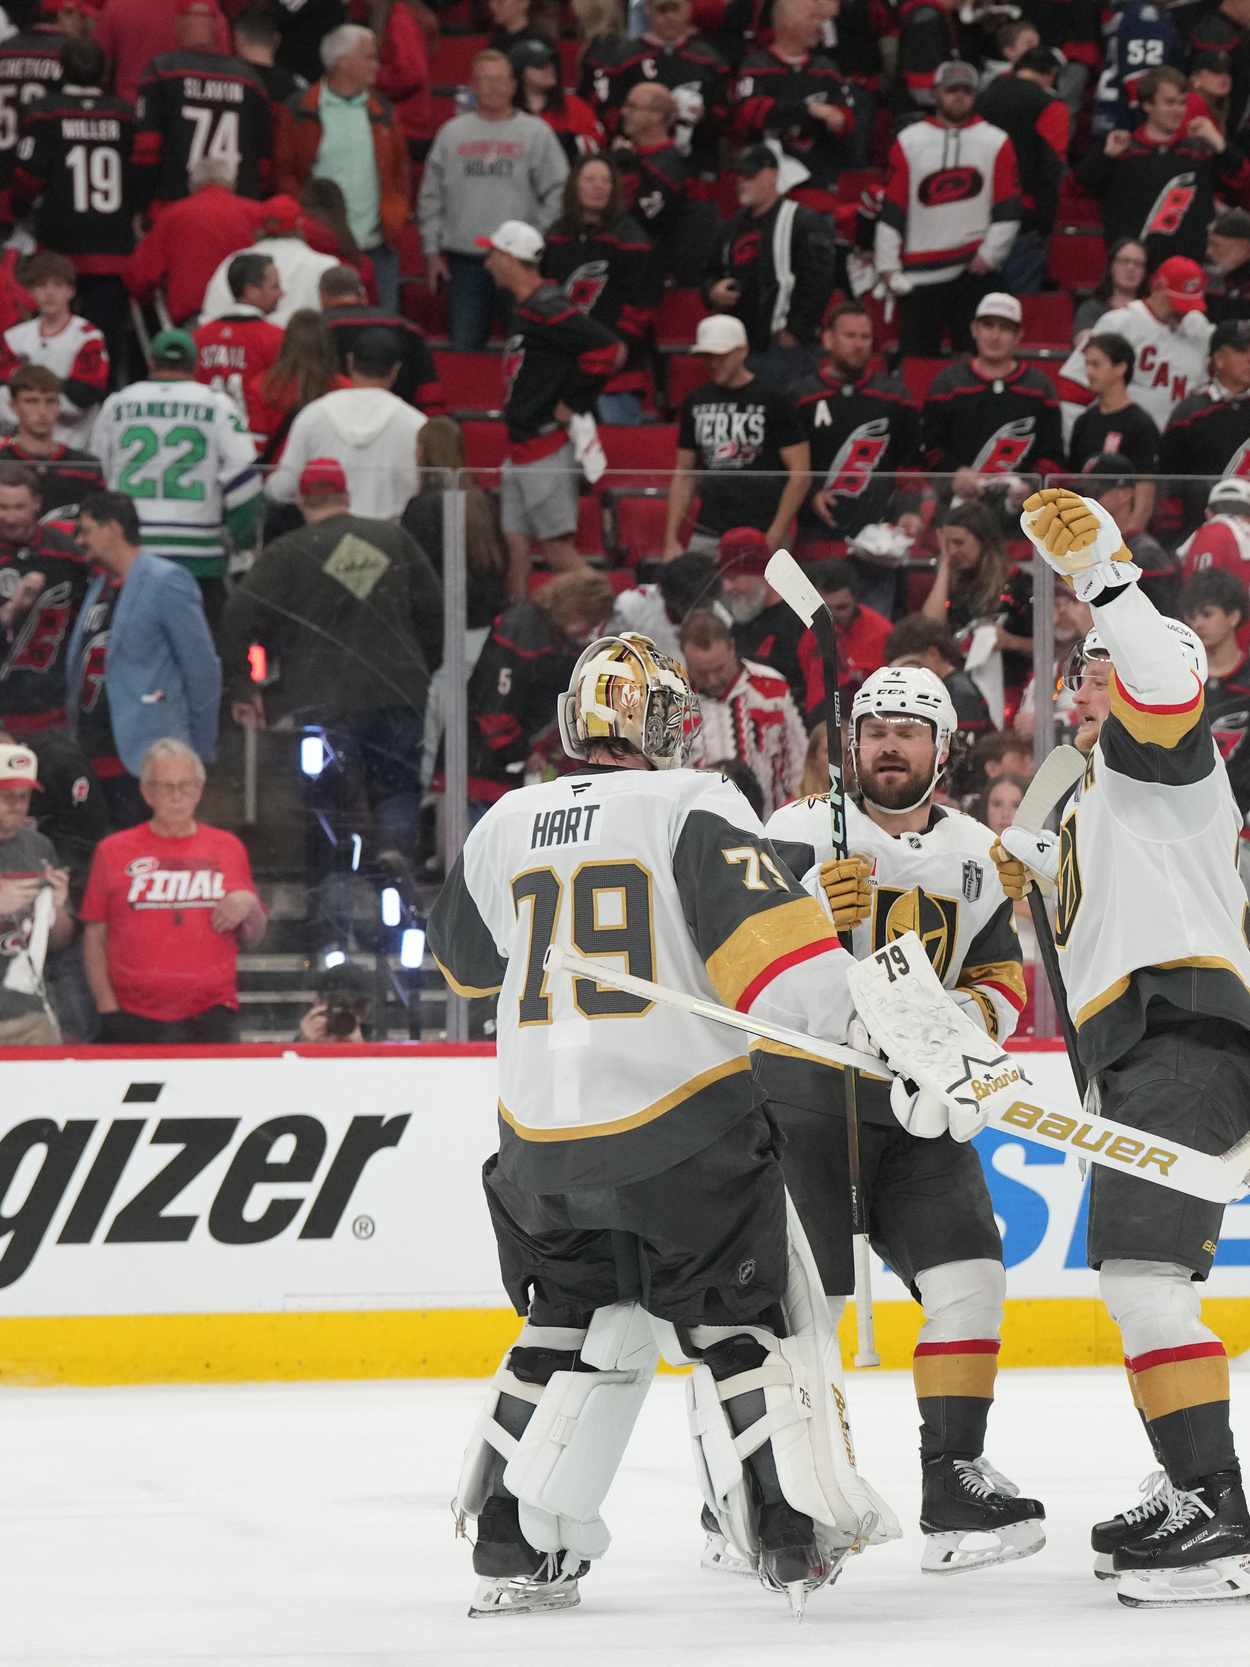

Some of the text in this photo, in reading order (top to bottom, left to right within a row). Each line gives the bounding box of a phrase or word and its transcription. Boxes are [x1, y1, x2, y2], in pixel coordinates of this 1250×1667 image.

[1127, 39, 1165, 66] 52
[184, 77, 245, 104] SLAVIN
[62, 119, 121, 141] MILLER
[65, 145, 122, 214] 19
[115, 402, 214, 422] STANKOVEN
[694, 412, 766, 446] JERKS
[814, 399, 833, 428] A
[119, 426, 207, 500] 22
[531, 803, 601, 849] HART
[127, 869, 227, 903] FINAL
[510, 858, 658, 1028] 79
[874, 945, 910, 983] 79
[971, 1067, 1020, 1101] Brian's
[0, 1082, 413, 1291] gizer
